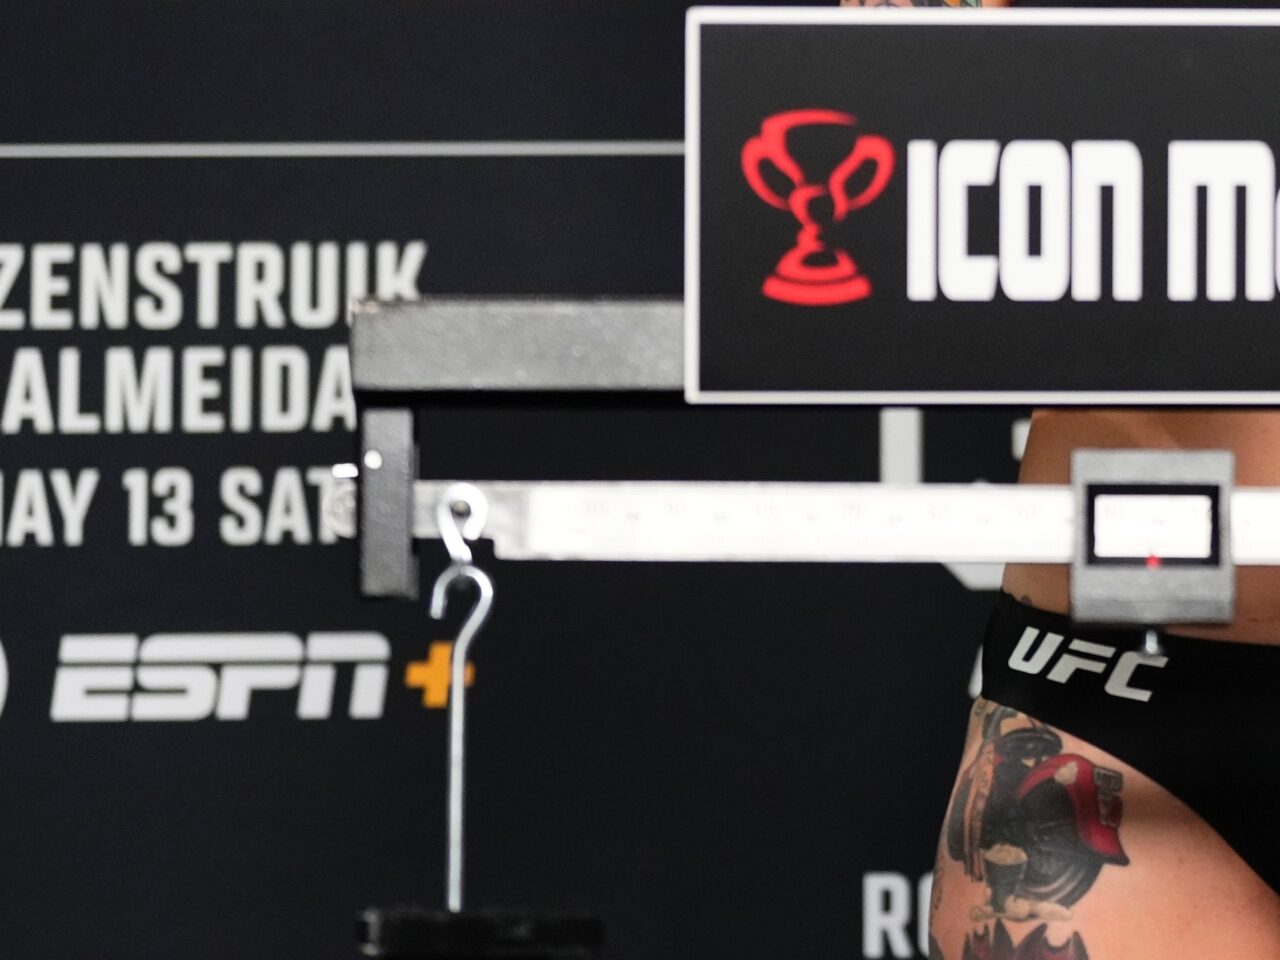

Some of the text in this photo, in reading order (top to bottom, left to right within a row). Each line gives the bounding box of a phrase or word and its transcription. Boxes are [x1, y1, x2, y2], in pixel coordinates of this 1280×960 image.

[906, 139, 1143, 303] ICON
[2, 345, 358, 434] ALMEIDA
[0, 466, 345, 547] AY 13 SAT
[1007, 626, 1169, 703] UFC
